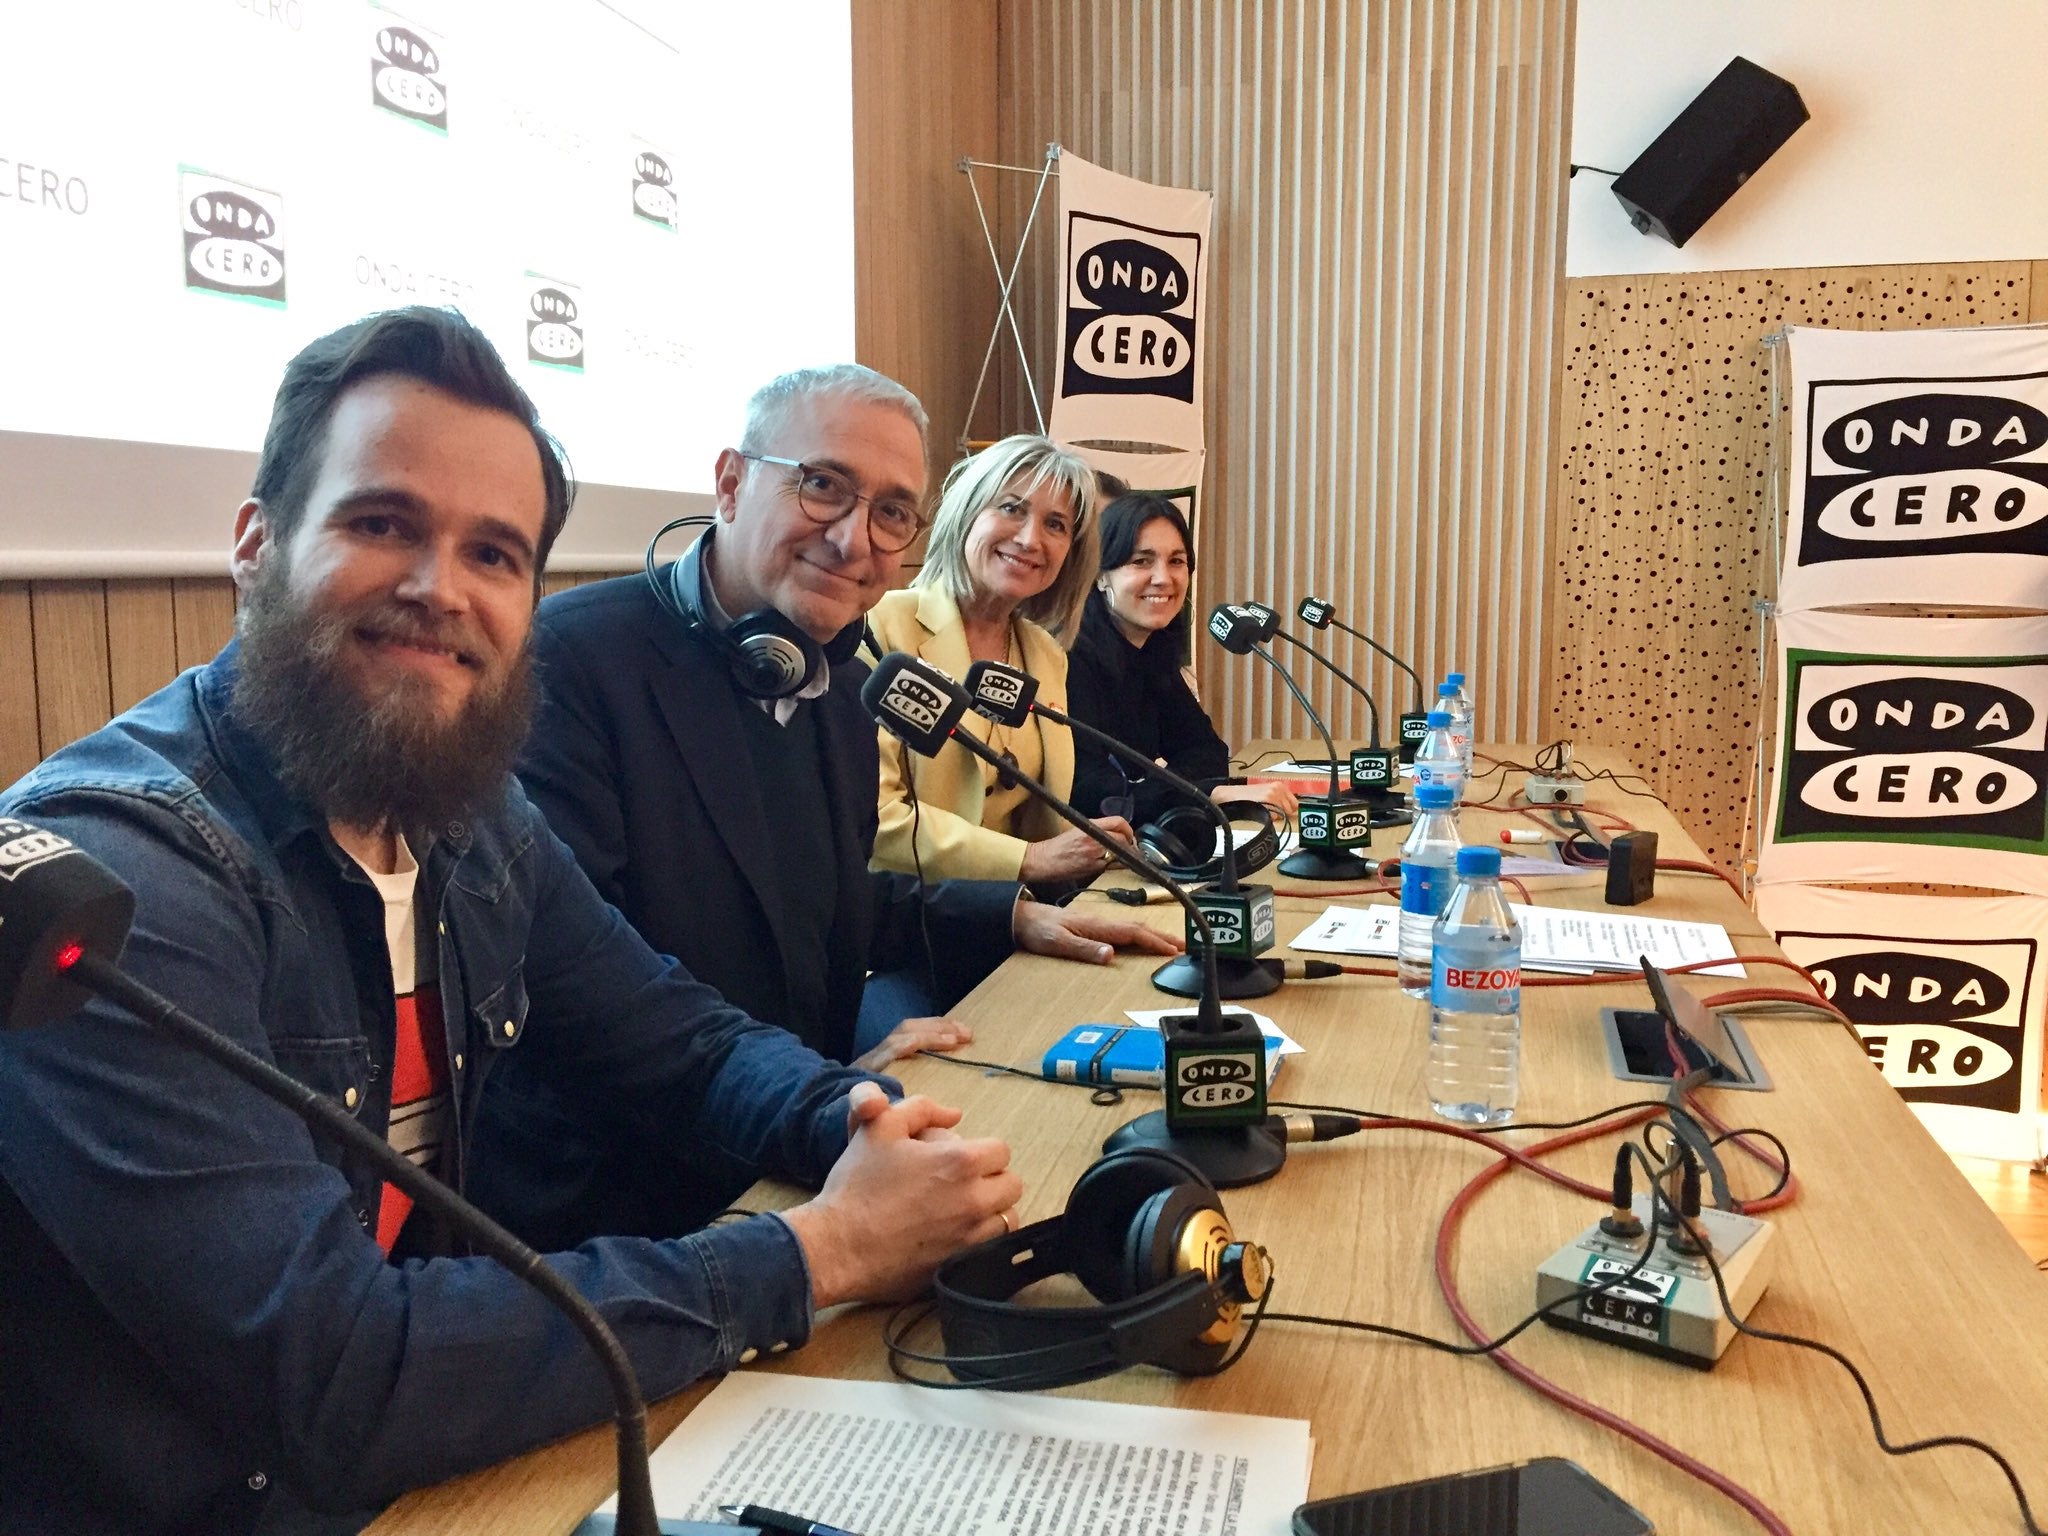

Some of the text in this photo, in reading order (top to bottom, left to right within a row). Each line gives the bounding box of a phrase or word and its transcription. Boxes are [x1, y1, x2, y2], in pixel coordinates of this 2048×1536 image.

[380, 29, 437, 72] ONDA
[387, 75, 436, 107] CERO
[636, 154, 671, 184] ONDA
[196, 196, 270, 234] ONDA
[204, 247, 270, 277] CERO
[1088, 255, 1179, 298] ONDA
[533, 292, 575, 319] ONDA
[1091, 324, 1177, 368] CERO
[1844, 416, 2027, 453] ONDA
[1850, 485, 2026, 527] CERO
[901, 680, 938, 708] ONDA
[984, 688, 1012, 701] CERO
[987, 676, 1015, 690] ONDA
[893, 695, 929, 722] CERO
[1829, 698, 2010, 732] ONDA
[1833, 765, 2007, 805] CERO
[1303, 815, 1324, 825] ONDA
[1305, 829, 1327, 838] CERO
[1339, 815, 1364, 825] ONDA
[1341, 826, 1364, 837] CERO
[1207, 914, 1235, 924] NDA
[1810, 969, 1986, 1006] ONDA
[1861, 1036, 1983, 1076] ERO
[1187, 1064, 1246, 1080] ONDA
[1192, 1087, 1246, 1102] CERO
[1602, 1261, 1665, 1283] ONDA
[1585, 1295, 1653, 1325] CERO
